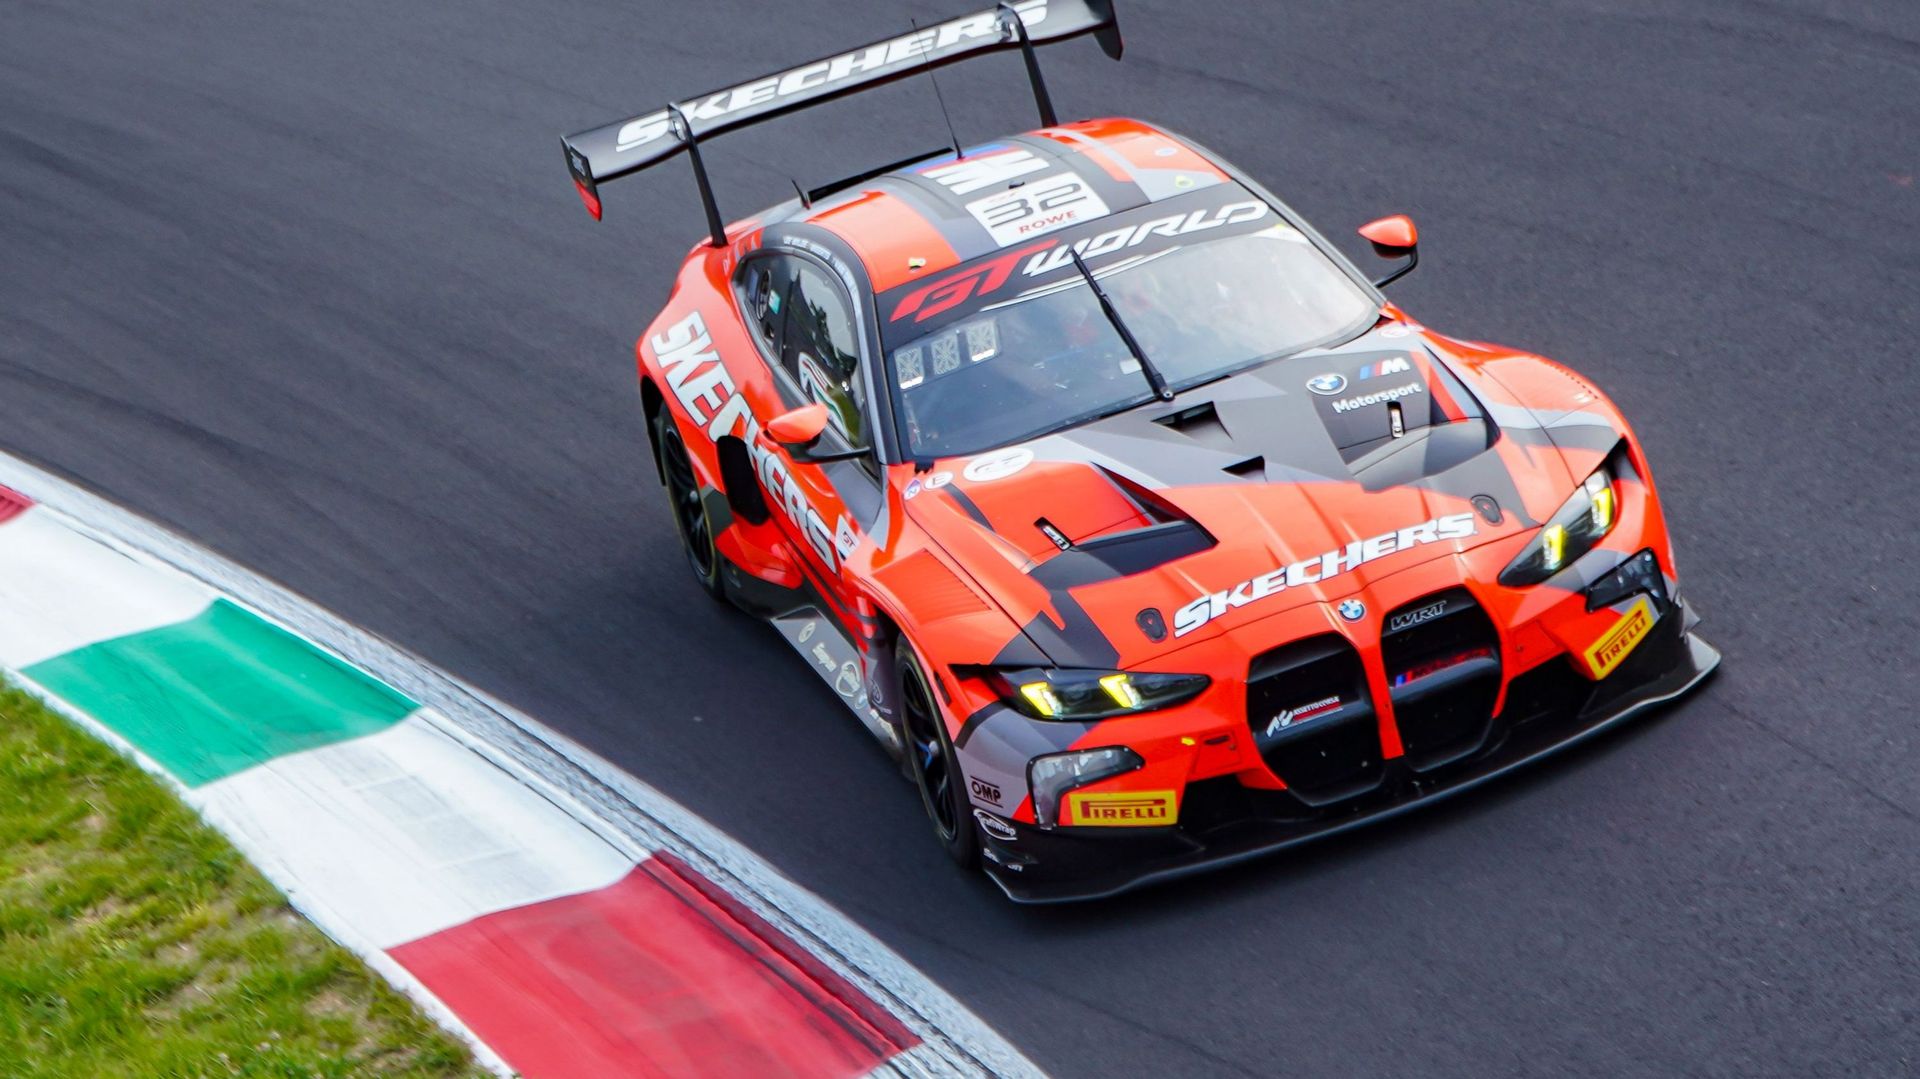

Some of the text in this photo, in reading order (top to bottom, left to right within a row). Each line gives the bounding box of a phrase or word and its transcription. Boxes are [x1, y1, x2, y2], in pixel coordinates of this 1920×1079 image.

[615, 0, 1049, 152] SKECHERS
[983, 183, 1087, 229] 32
[1019, 210, 1077, 234] ROWE
[889, 240, 1059, 323] GT
[1022, 200, 1270, 277] WORLD
[1332, 382, 1422, 414] Motorsport
[1173, 512, 1476, 639] SKECHERS
[1391, 600, 1448, 631] WRT
[1594, 609, 1647, 670] PIRELLI
[971, 780, 1002, 803] OMP
[1080, 798, 1167, 820] PIRELLI
